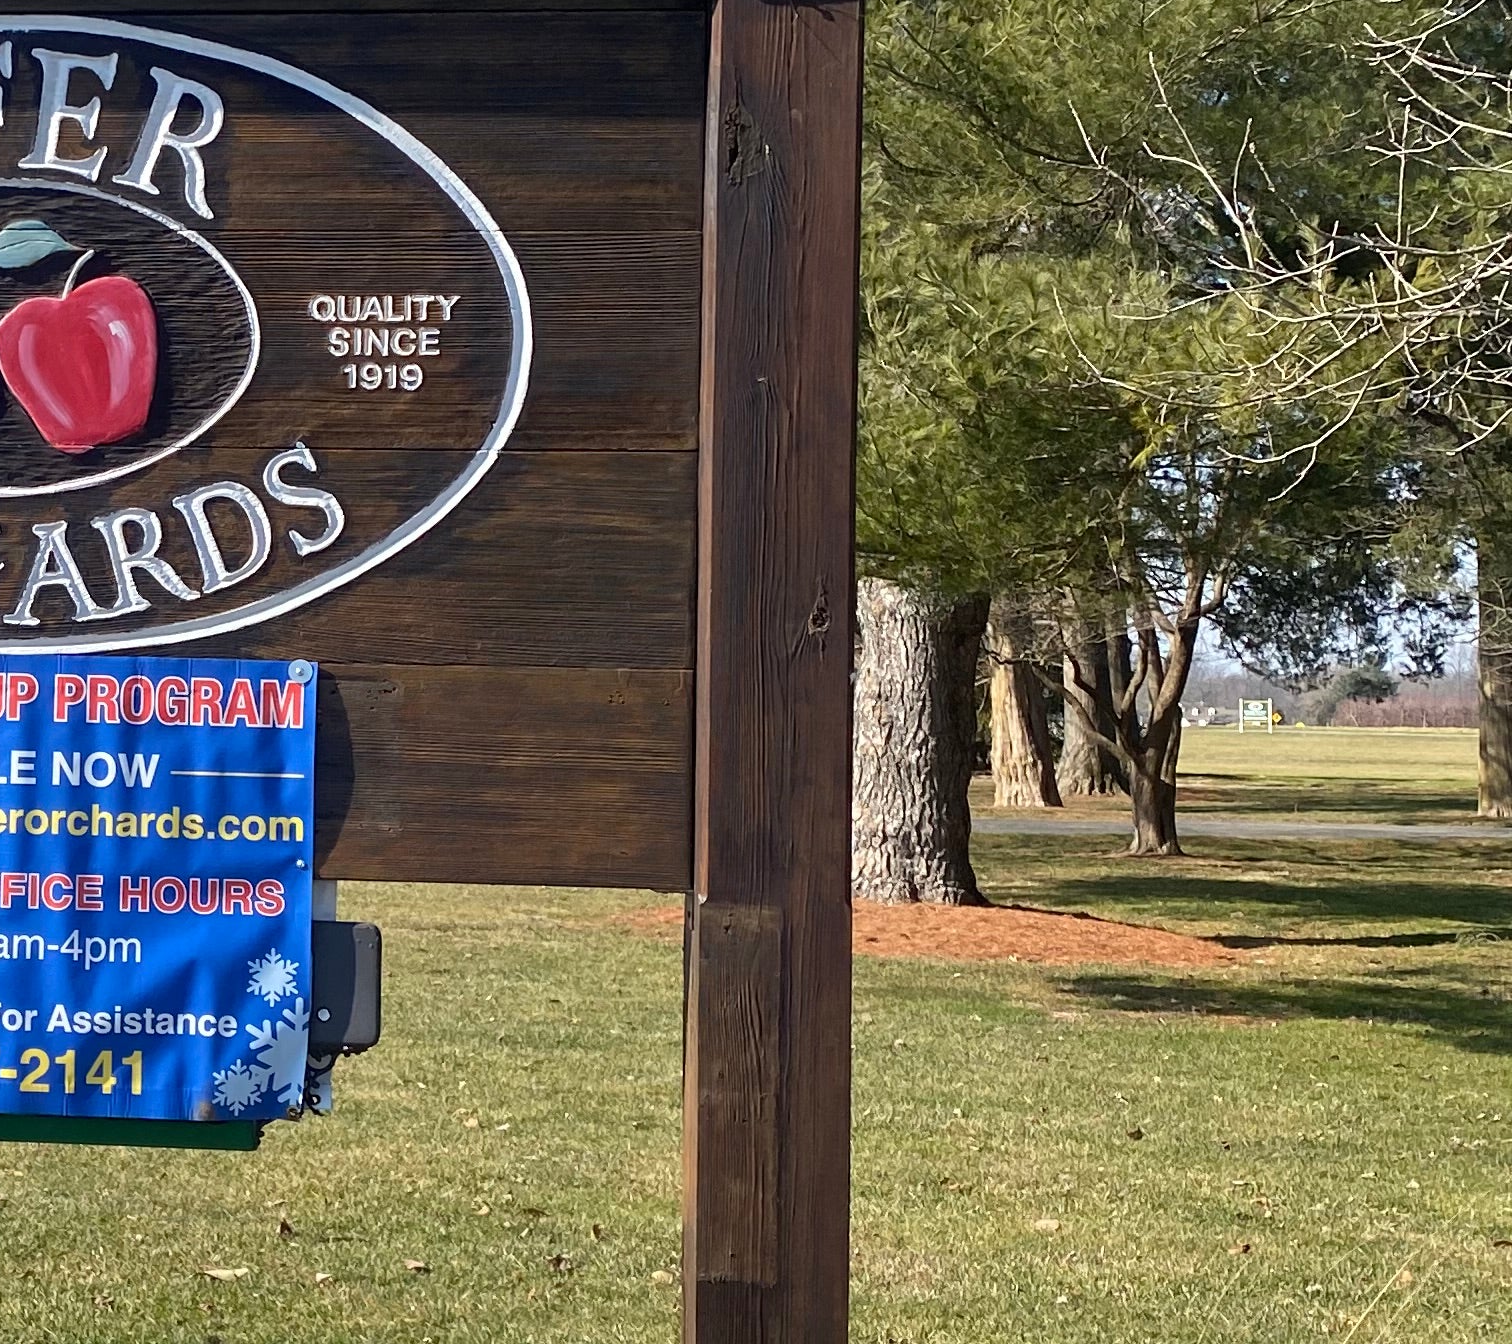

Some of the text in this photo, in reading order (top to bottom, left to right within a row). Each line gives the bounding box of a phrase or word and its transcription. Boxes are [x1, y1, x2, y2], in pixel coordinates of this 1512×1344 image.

[309, 294, 461, 322] QUALITY
[328, 327, 441, 356] SINCE
[343, 362, 424, 391] 1919
[53, 674, 305, 728] PROGRAM
[53, 750, 160, 789] NOW
[119, 874, 286, 917] HOURS
[45, 1003, 238, 1038] Assistance
